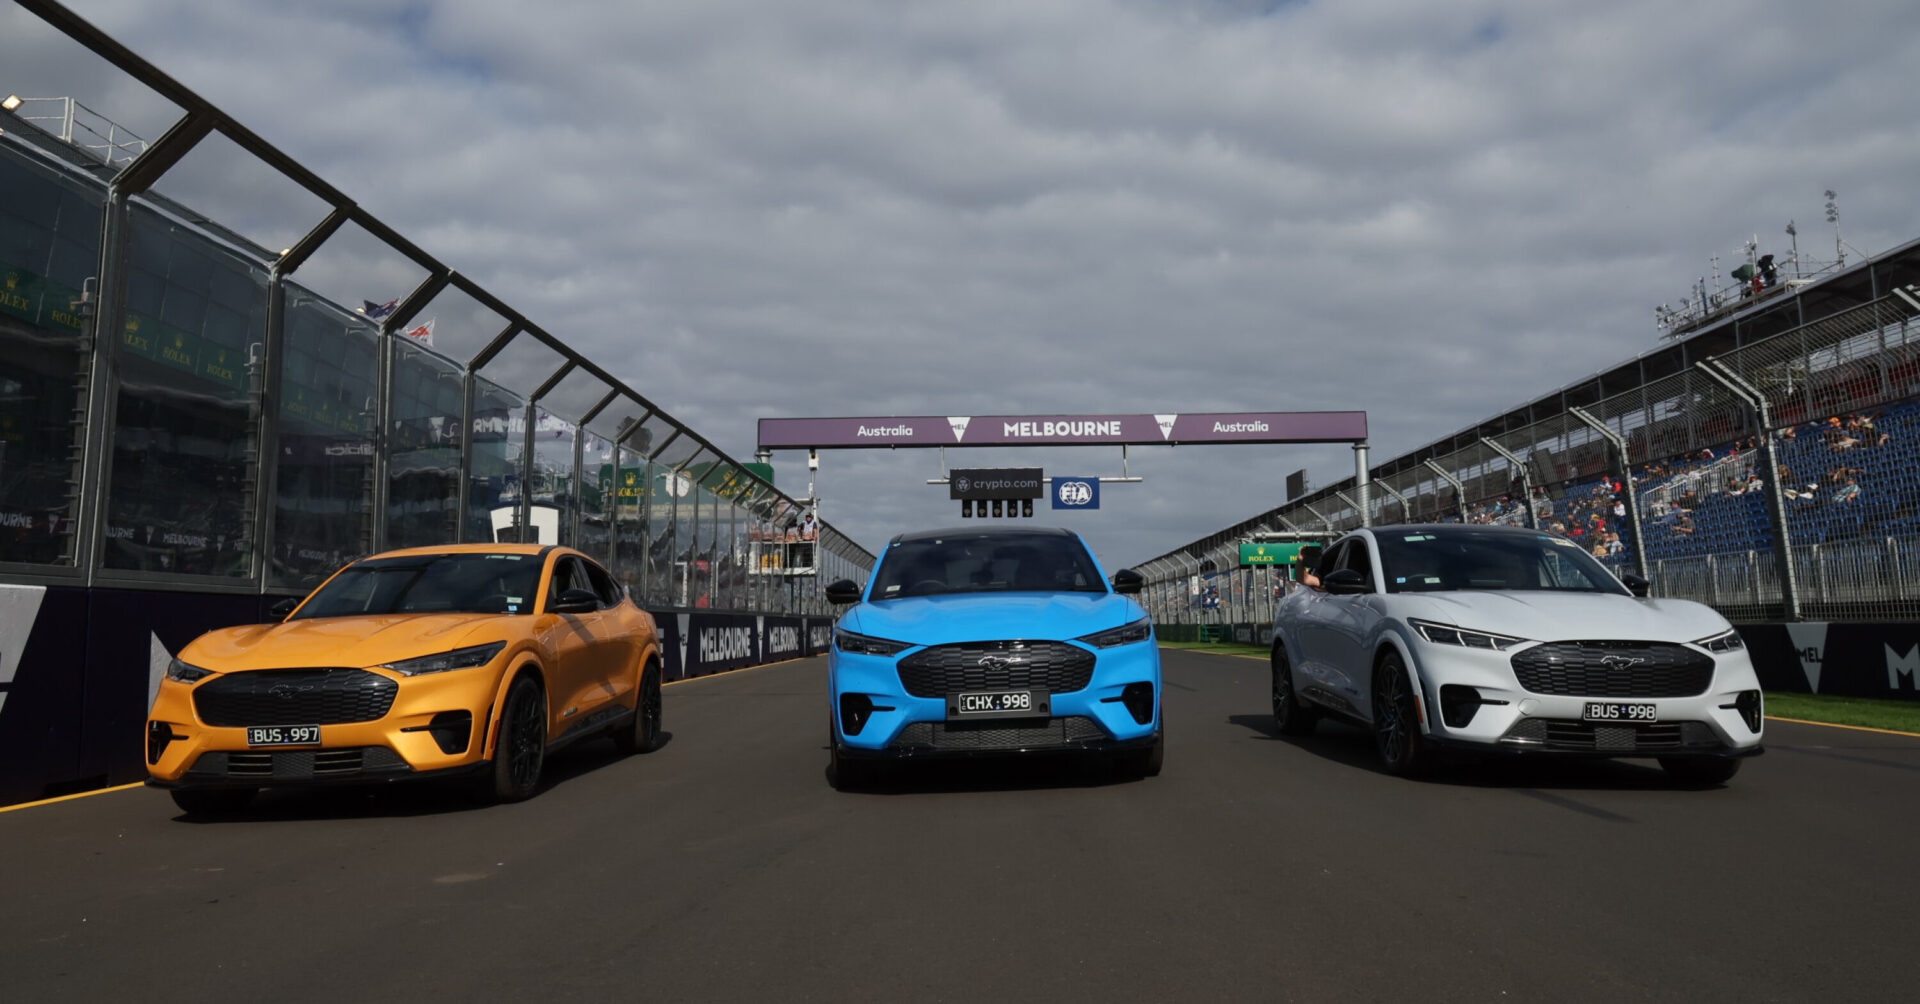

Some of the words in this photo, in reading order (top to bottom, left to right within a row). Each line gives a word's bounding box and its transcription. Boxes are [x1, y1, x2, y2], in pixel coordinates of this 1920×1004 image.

[52, 309, 82, 329] ROLE
[857, 425, 914, 436] Australia
[1003, 421, 1121, 437] MELBOURNE
[1212, 420, 1269, 432] Australia
[973, 479, 1038, 489] crypto.com
[1061, 487, 1089, 500] FIA
[699, 627, 751, 663] MELBOURNE
[769, 626, 799, 654] MELBOURNE
[1795, 646, 1823, 663] MEL
[966, 695, 993, 710] CHX
[1002, 694, 1029, 709] 998
[1591, 704, 1619, 718] BUS
[1628, 705, 1656, 719] 998
[254, 729, 282, 743] BUS
[290, 727, 318, 741] 997
